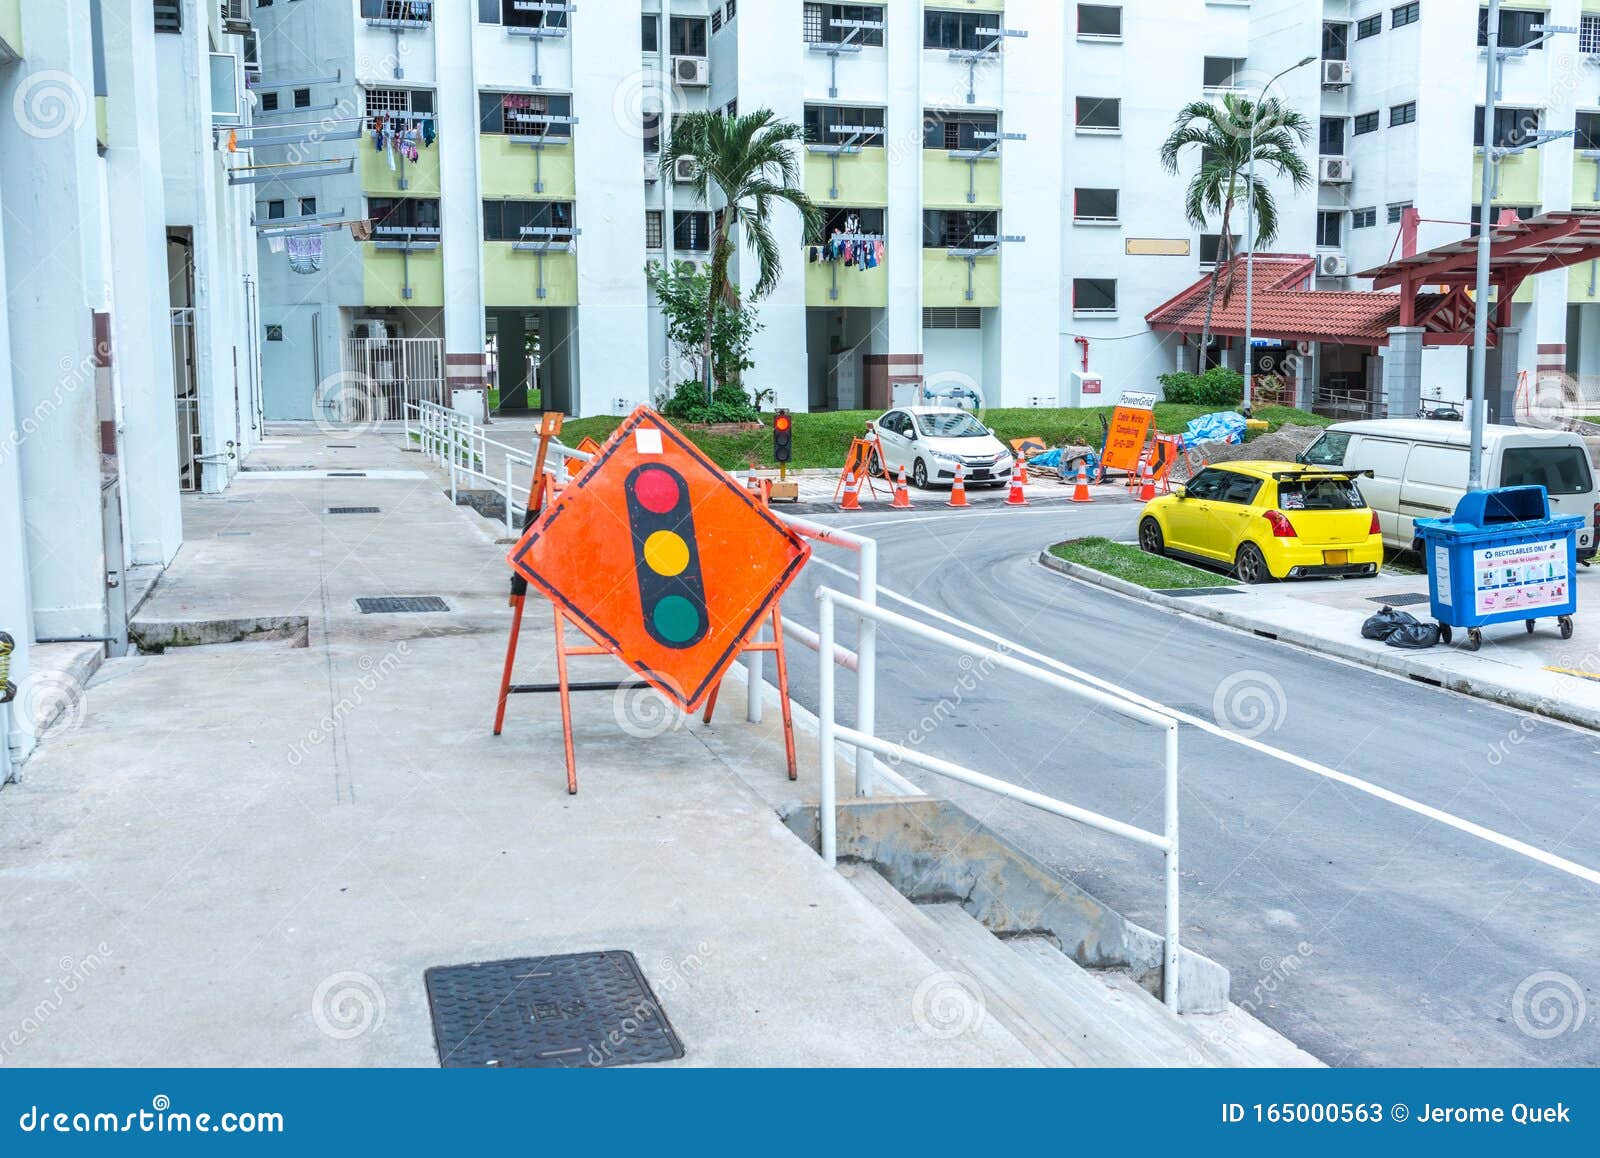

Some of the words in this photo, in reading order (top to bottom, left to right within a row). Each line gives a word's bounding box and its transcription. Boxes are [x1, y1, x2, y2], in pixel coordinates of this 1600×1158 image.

[1120, 395, 1154, 406] PowerGrid
[1494, 547, 1532, 557] RECYCLABLES
[1533, 544, 1548, 553] ONLY
